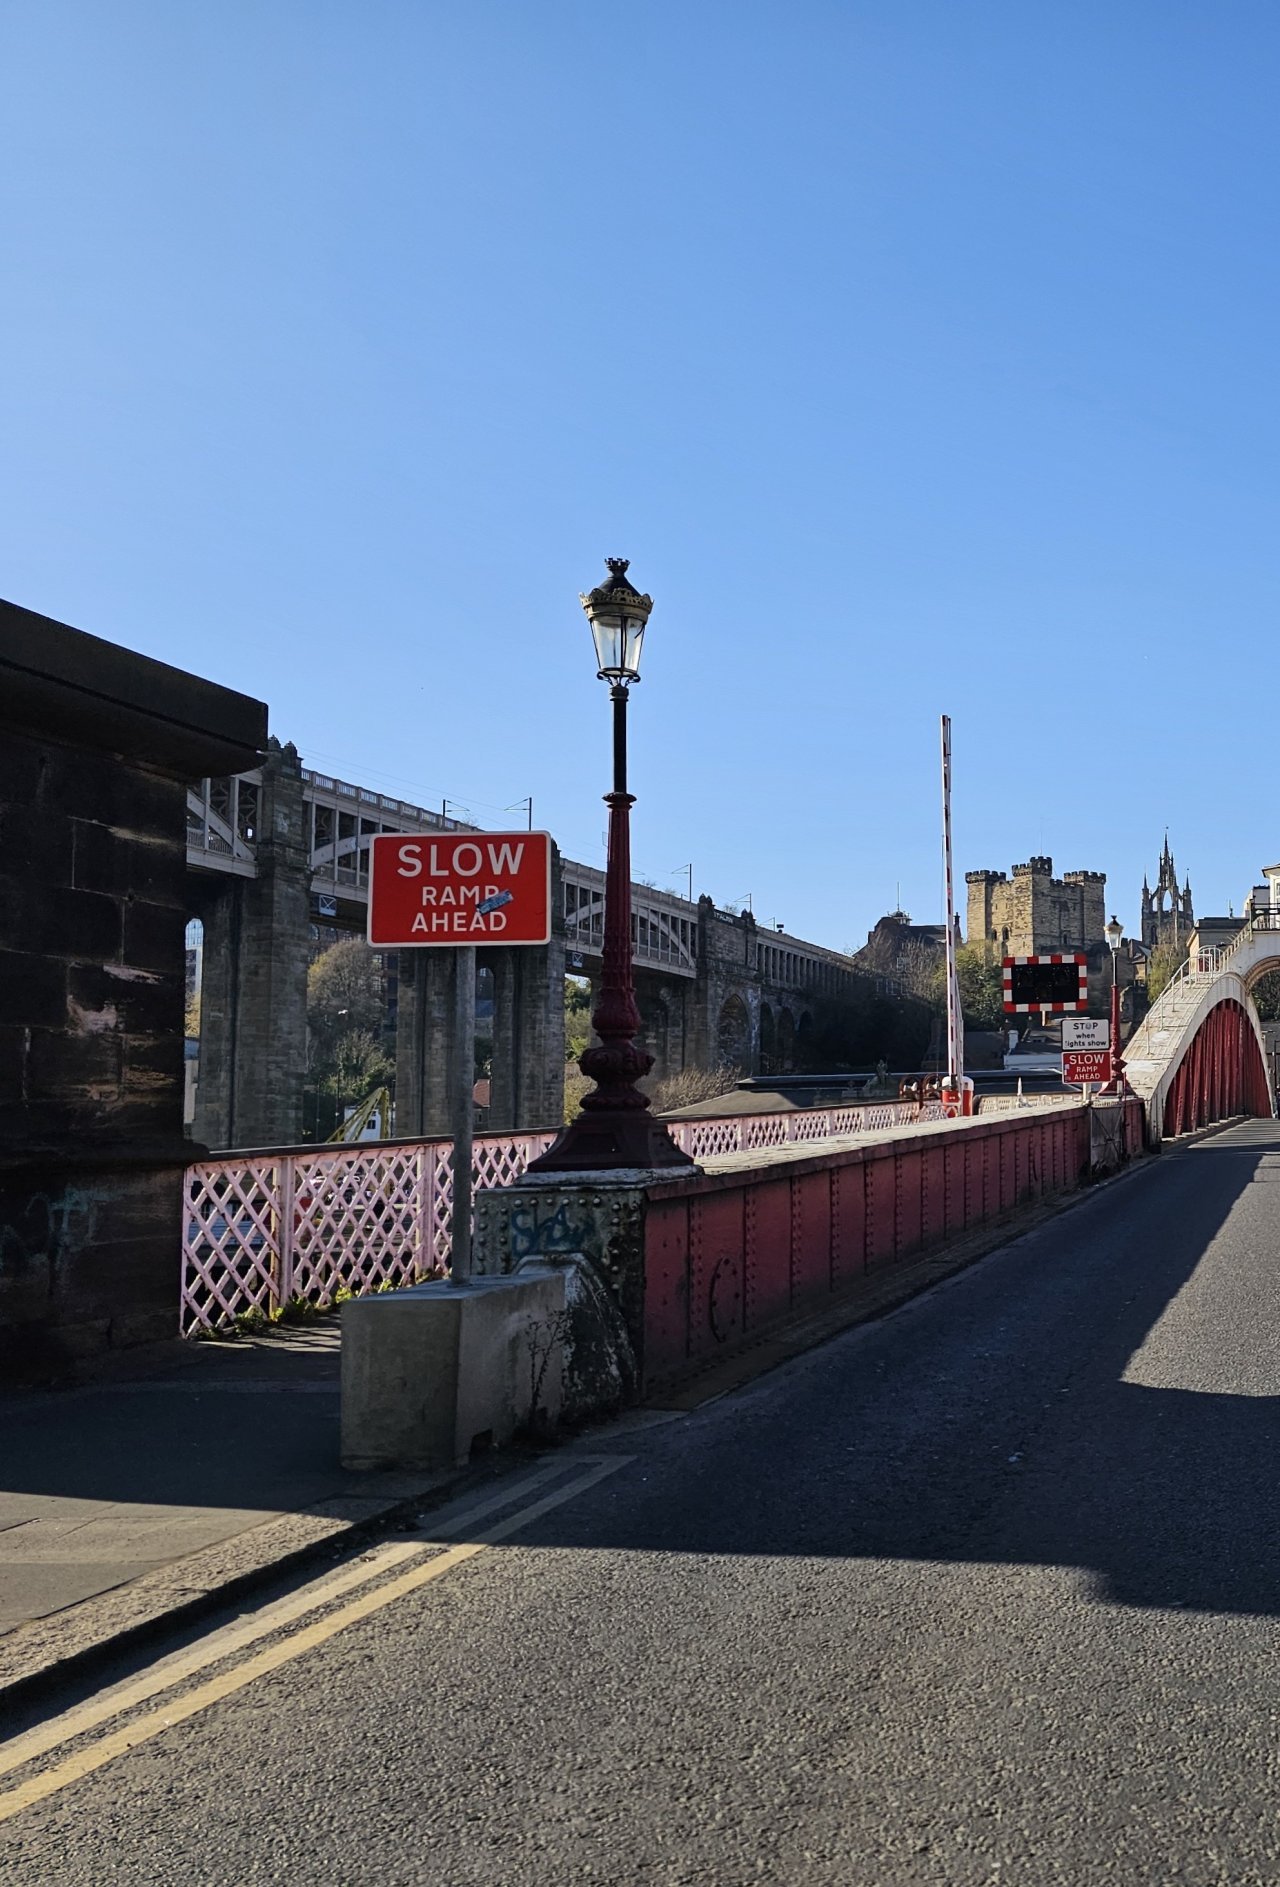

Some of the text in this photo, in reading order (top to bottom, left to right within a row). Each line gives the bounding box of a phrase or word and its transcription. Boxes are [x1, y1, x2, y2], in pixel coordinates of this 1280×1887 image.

[397, 842, 524, 877] SLOW
[422, 885, 500, 906] RAMP
[411, 911, 507, 933] AHEAD
[1072, 1022, 1098, 1030] STOP
[1069, 1054, 1104, 1065] SLOW
[1076, 1065, 1098, 1073] RAMP
